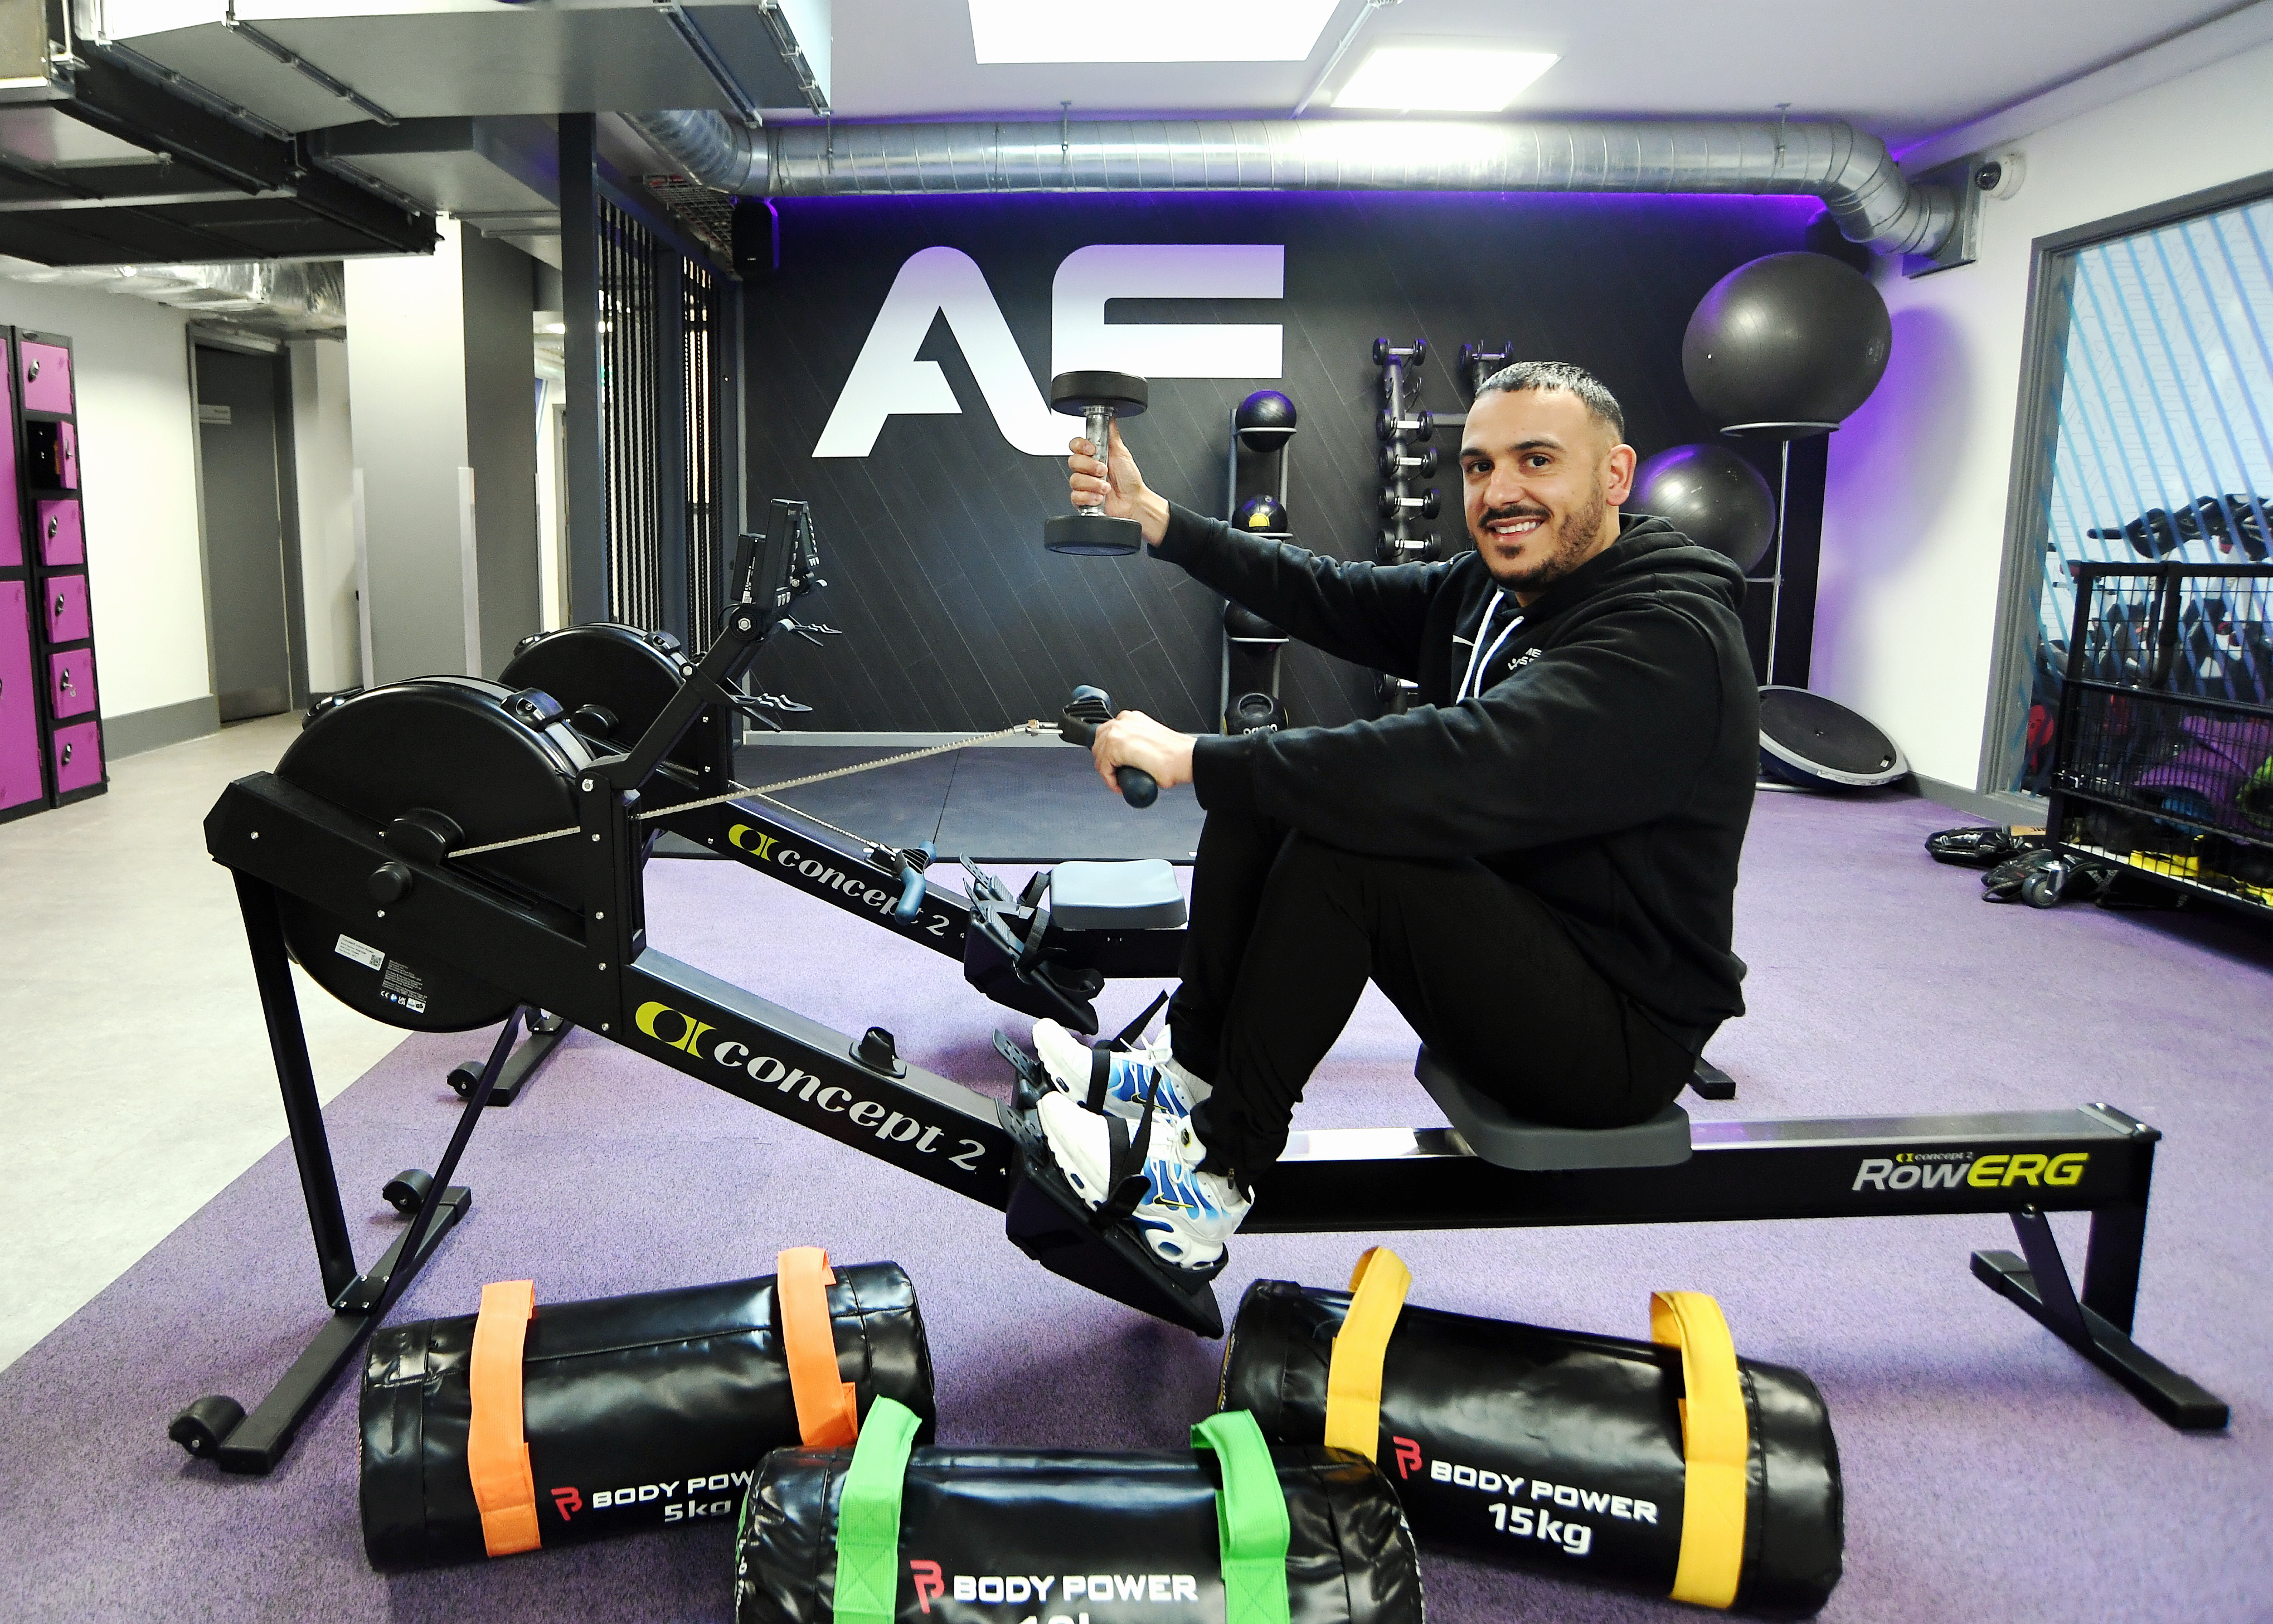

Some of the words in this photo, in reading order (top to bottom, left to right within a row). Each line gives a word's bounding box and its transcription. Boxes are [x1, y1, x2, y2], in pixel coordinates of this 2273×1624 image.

[926, 915, 950, 936] 2
[714, 1041, 944, 1153] concept
[948, 1139, 985, 1170] 2
[592, 1481, 680, 1509] BODY
[687, 1469, 754, 1495] POW
[1431, 1460, 1524, 1496] BODY
[1531, 1480, 1658, 1524] POWER
[1488, 1503, 1592, 1555] 15kg
[954, 1574, 1055, 1602] BODY
[1062, 1574, 1199, 1601] POWER
